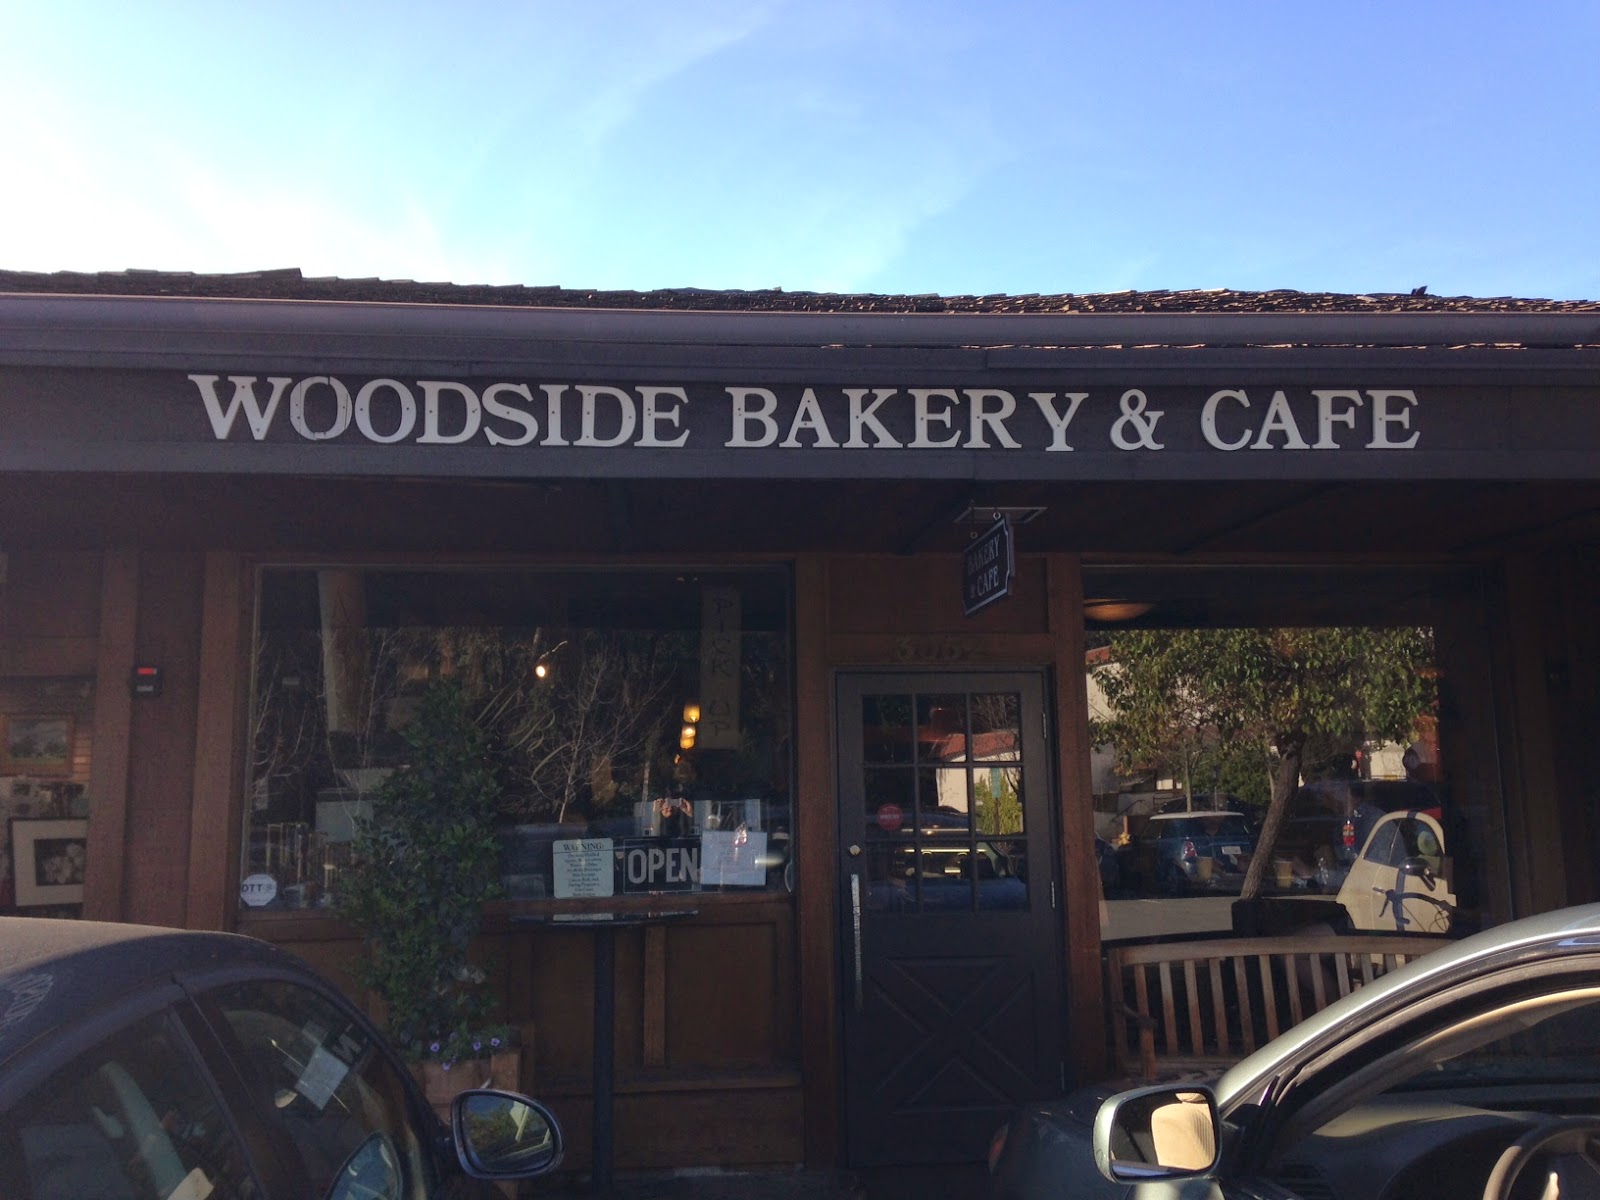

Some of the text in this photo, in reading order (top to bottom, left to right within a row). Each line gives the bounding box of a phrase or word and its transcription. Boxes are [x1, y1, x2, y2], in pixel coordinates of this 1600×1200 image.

[188, 374, 1421, 452] WOODSIDE BAKERY & CAFE
[967, 533, 1000, 576] BAKERY
[977, 564, 999, 597] CAFE
[627, 847, 698, 884] OPEN
